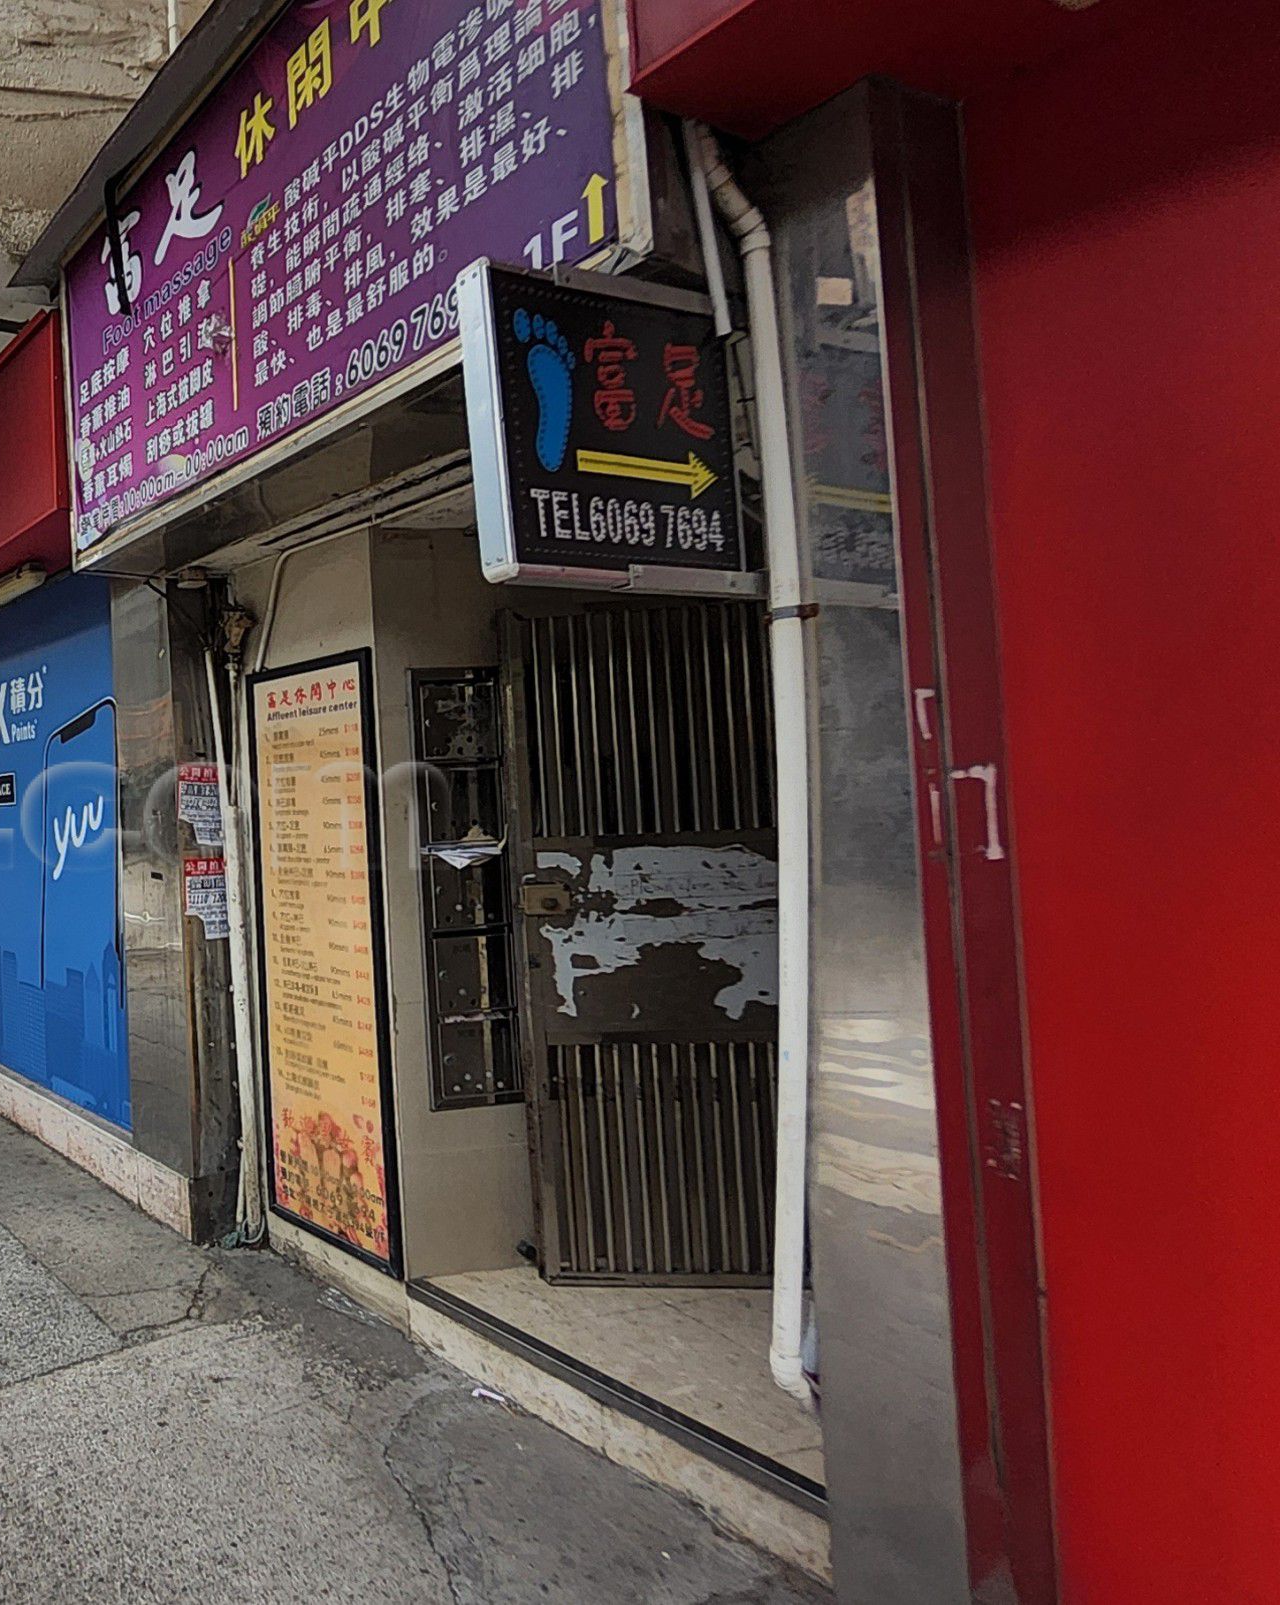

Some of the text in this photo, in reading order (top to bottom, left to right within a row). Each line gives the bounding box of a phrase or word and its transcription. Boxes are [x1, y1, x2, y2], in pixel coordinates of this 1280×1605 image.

[102, 226, 232, 355] Foot massage
[584, 319, 716, 441] 富足
[660, 504, 725, 552] 7694
[266, 700, 358, 722] Affluent leisure center
[52, 795, 104, 881] yuu
